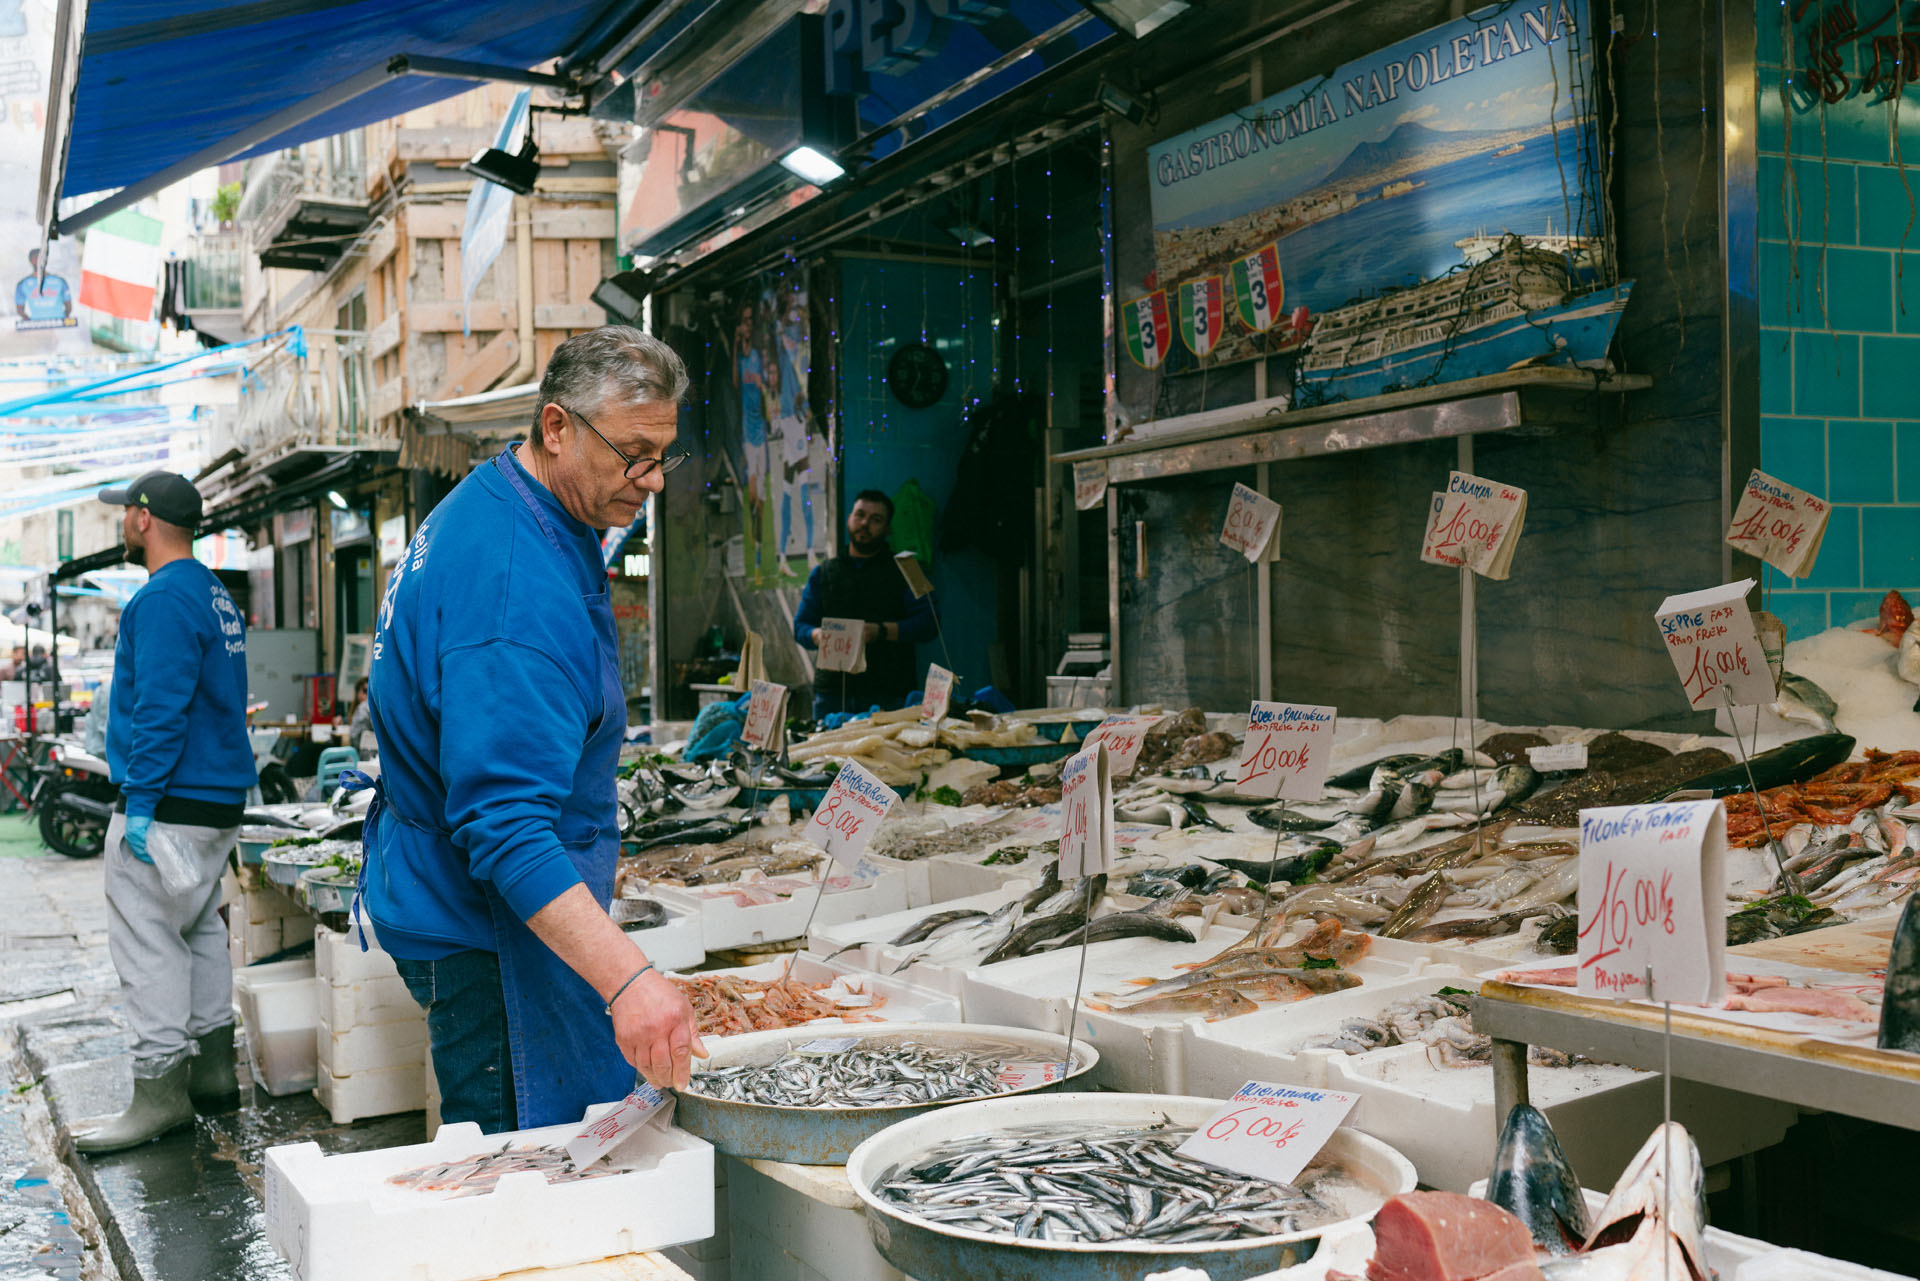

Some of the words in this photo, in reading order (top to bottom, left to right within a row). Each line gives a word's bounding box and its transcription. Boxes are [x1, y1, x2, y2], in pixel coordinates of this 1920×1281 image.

[1156, 88, 1339, 188] GASTRONOMIA
[1344, 0, 1578, 118] NAPOLETANA
[1251, 280, 1267, 311] 3
[1141, 322, 1156, 349] 3
[1194, 306, 1208, 336] 3
[1660, 612, 1704, 635] SEPPIE
